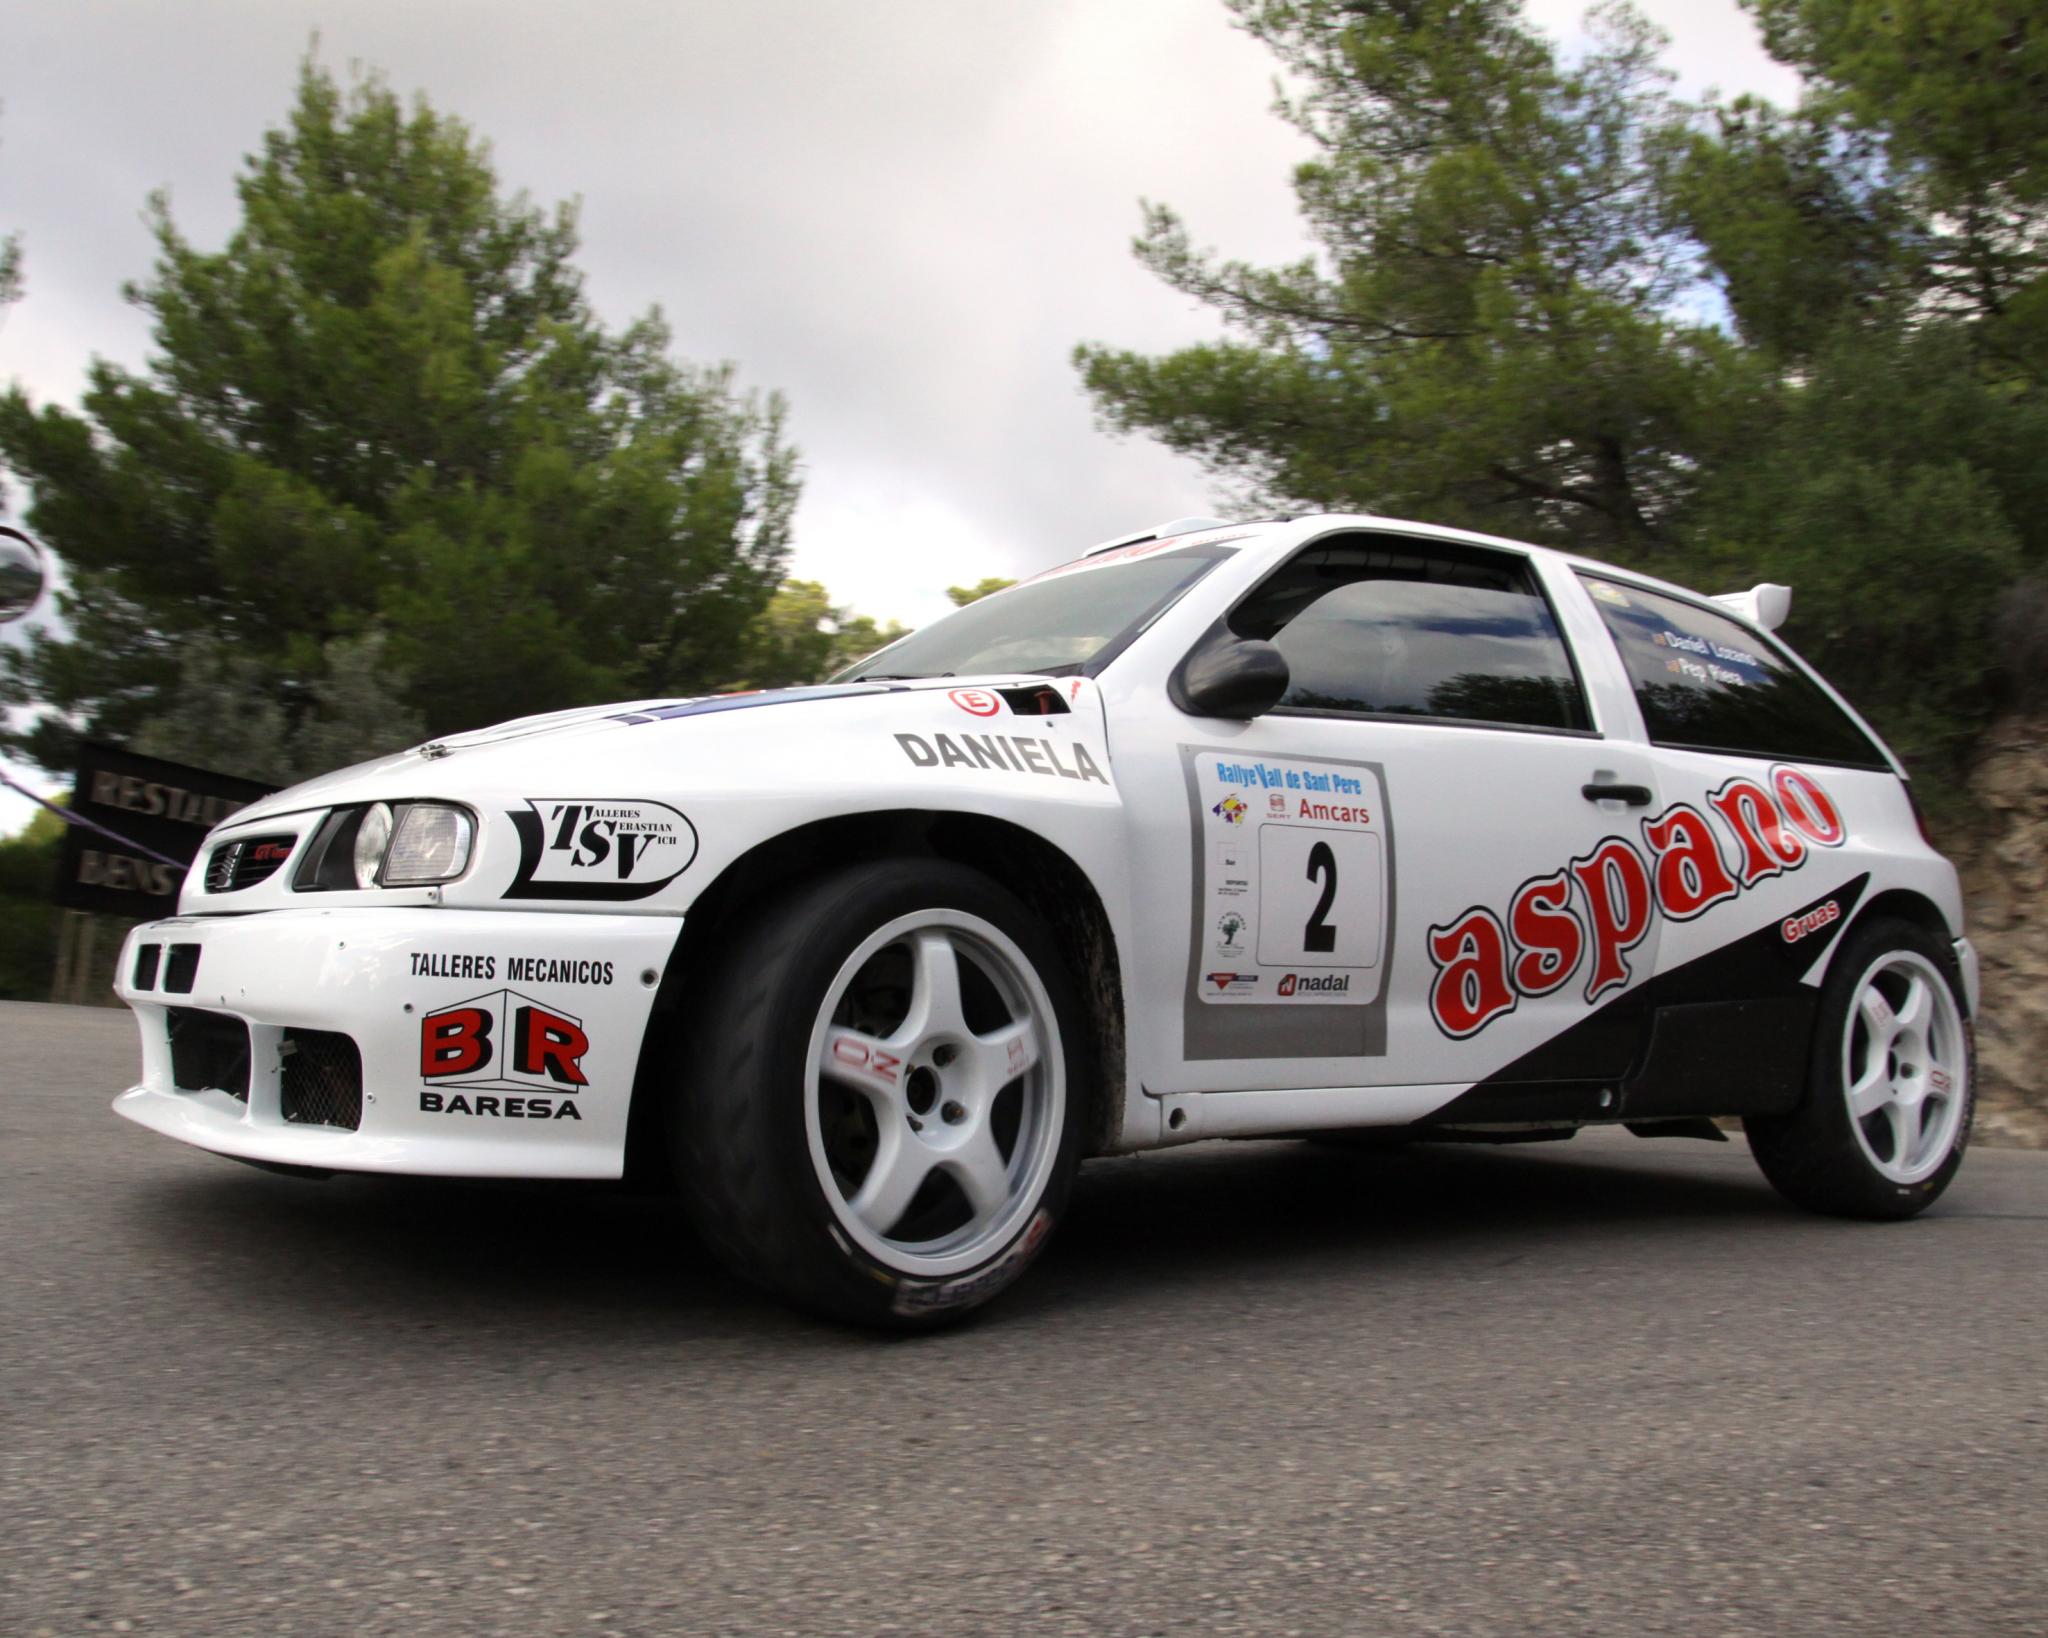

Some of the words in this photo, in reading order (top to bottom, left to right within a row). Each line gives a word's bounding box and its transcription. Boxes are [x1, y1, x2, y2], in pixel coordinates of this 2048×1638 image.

[893, 733, 1110, 785] DANIELA
[1216, 762, 1256, 788] Rallye
[1254, 763, 1283, 788] Vall
[1286, 770, 1301, 789] de
[1303, 770, 1331, 792] Sant
[1332, 774, 1361, 795] Pere
[1299, 798, 1370, 824] Amcars
[1304, 841, 1338, 952] 2
[1427, 763, 1846, 1041] aspano
[1781, 900, 1840, 943] Gruas
[411, 952, 496, 980] TALLERES
[507, 957, 614, 985] MECANICOS
[1298, 974, 1350, 991] nadal
[419, 1092, 582, 1121] BARESA
